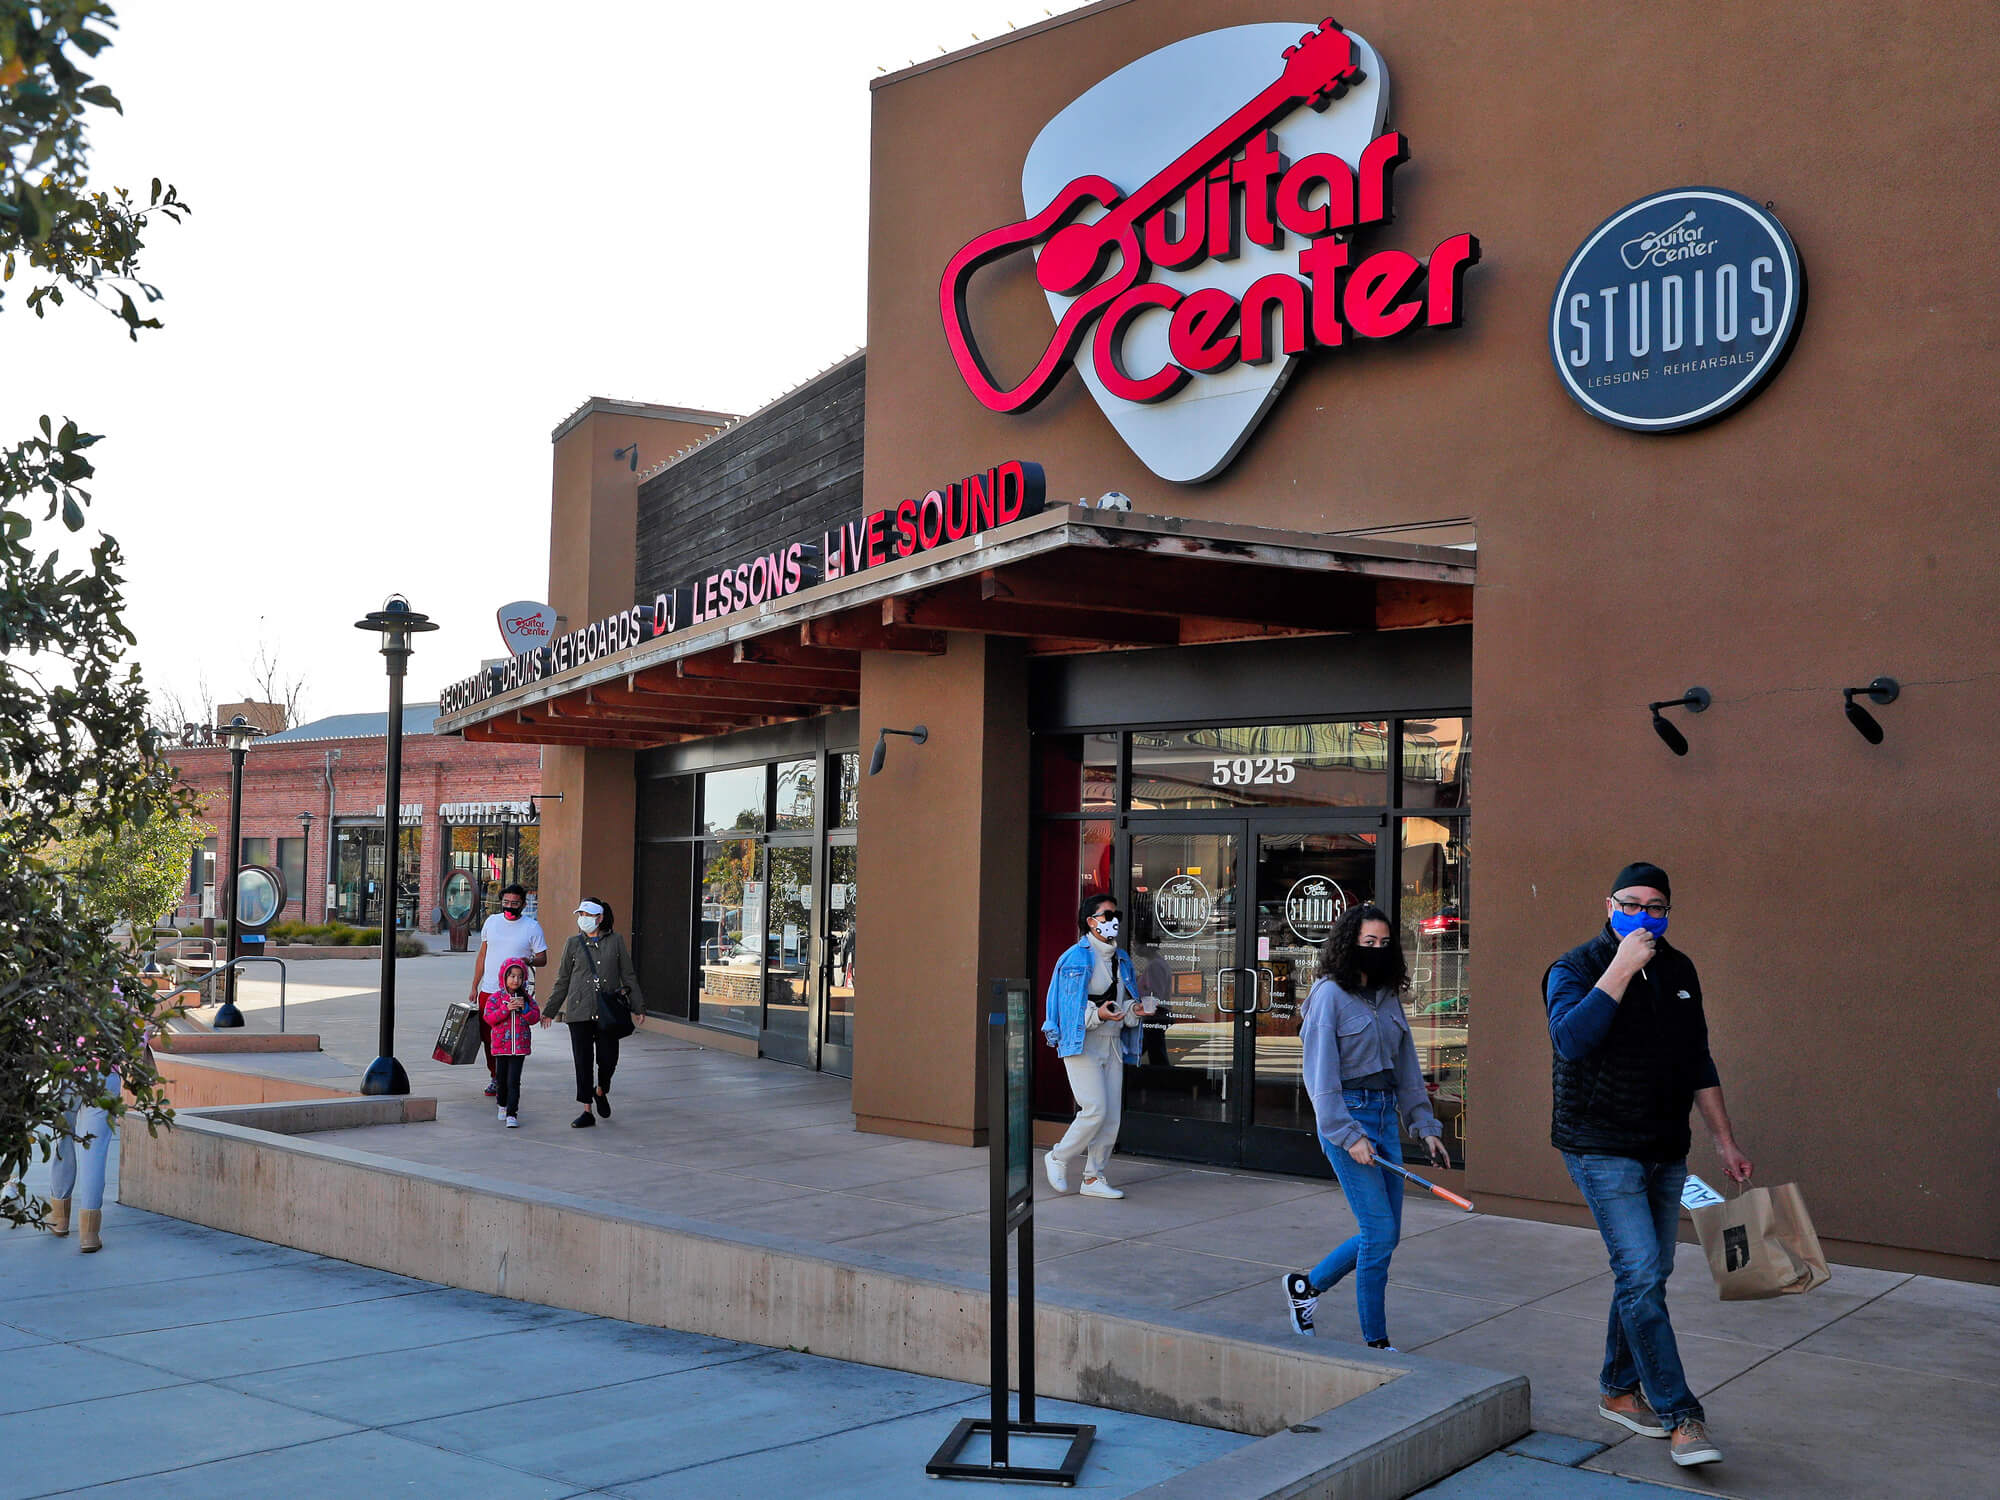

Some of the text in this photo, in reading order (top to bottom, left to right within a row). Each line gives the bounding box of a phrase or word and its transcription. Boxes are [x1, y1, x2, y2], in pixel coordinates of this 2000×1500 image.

[1652, 241, 1715, 267] Center
[1094, 232, 1478, 402] Center
[1570, 256, 1773, 367] STUDIOS
[1588, 351, 1755, 388] LESSONS REHEARSALS
[440, 460, 1025, 716] RECORDING DRUMS KEYBOARDS DJ LESSONS LIVE SOUND
[1212, 757, 1296, 786] 5925
[1160, 897, 1205, 919] STUDIOS
[1290, 898, 1340, 922] STUDIOS
